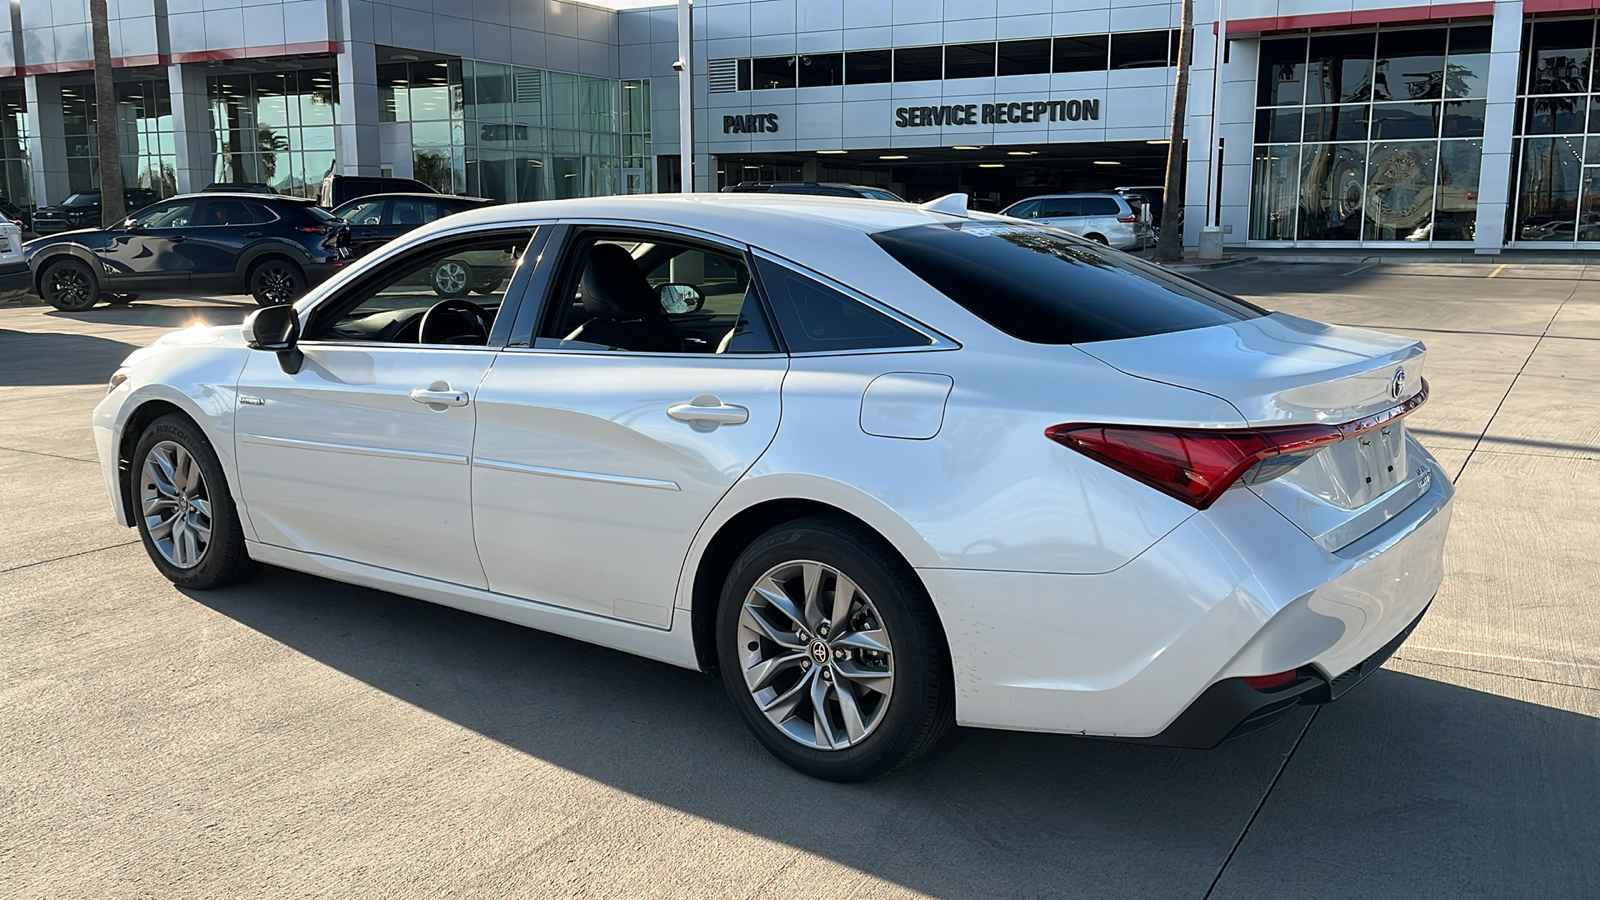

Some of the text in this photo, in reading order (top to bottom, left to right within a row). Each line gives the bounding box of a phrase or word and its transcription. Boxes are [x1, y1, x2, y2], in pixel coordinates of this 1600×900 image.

[723, 113, 779, 134] PARTS
[895, 98, 1099, 128] SERVICE RECEPTION
